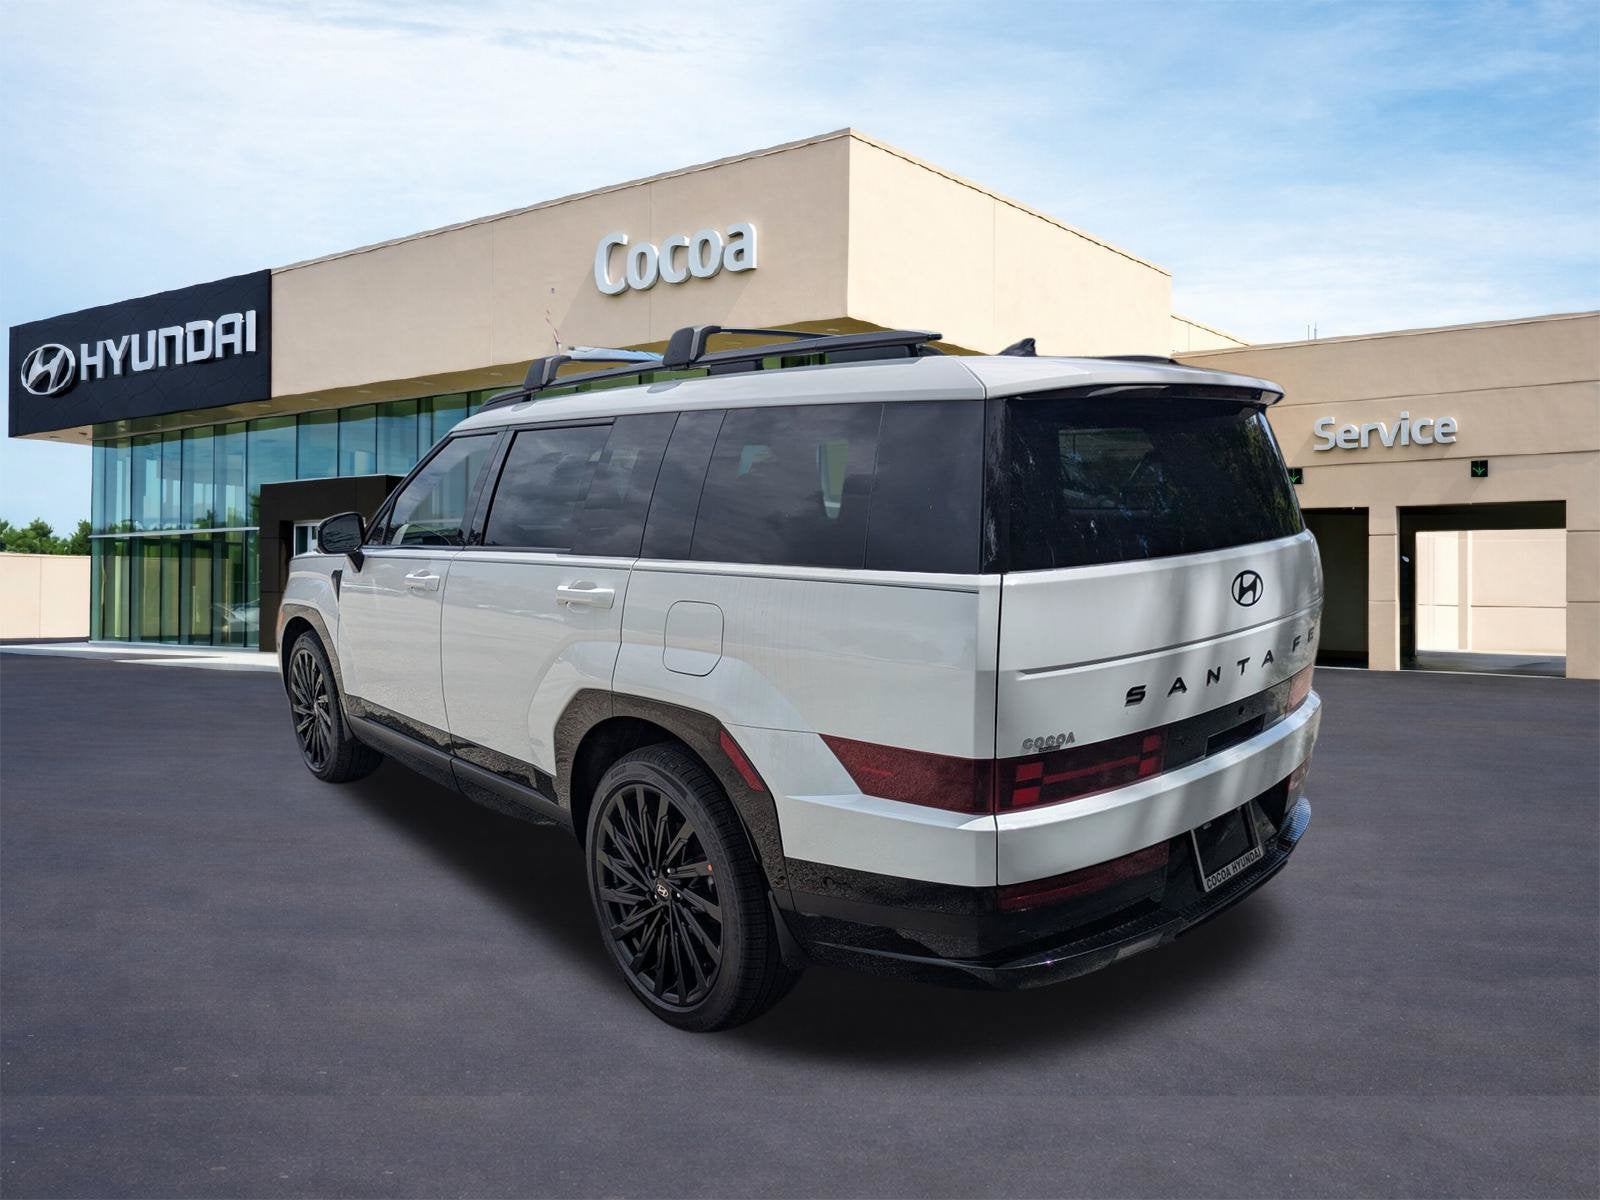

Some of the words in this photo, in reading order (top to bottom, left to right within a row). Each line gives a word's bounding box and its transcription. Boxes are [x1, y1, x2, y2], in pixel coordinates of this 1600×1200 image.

[594, 222, 757, 295] Cocoa
[80, 310, 256, 381] HYUNDAI
[1313, 411, 1457, 451] Service
[1124, 649, 1274, 707] SANTA
[1206, 867, 1232, 890] COCOA
[1231, 847, 1262, 874] HYUNDAI
